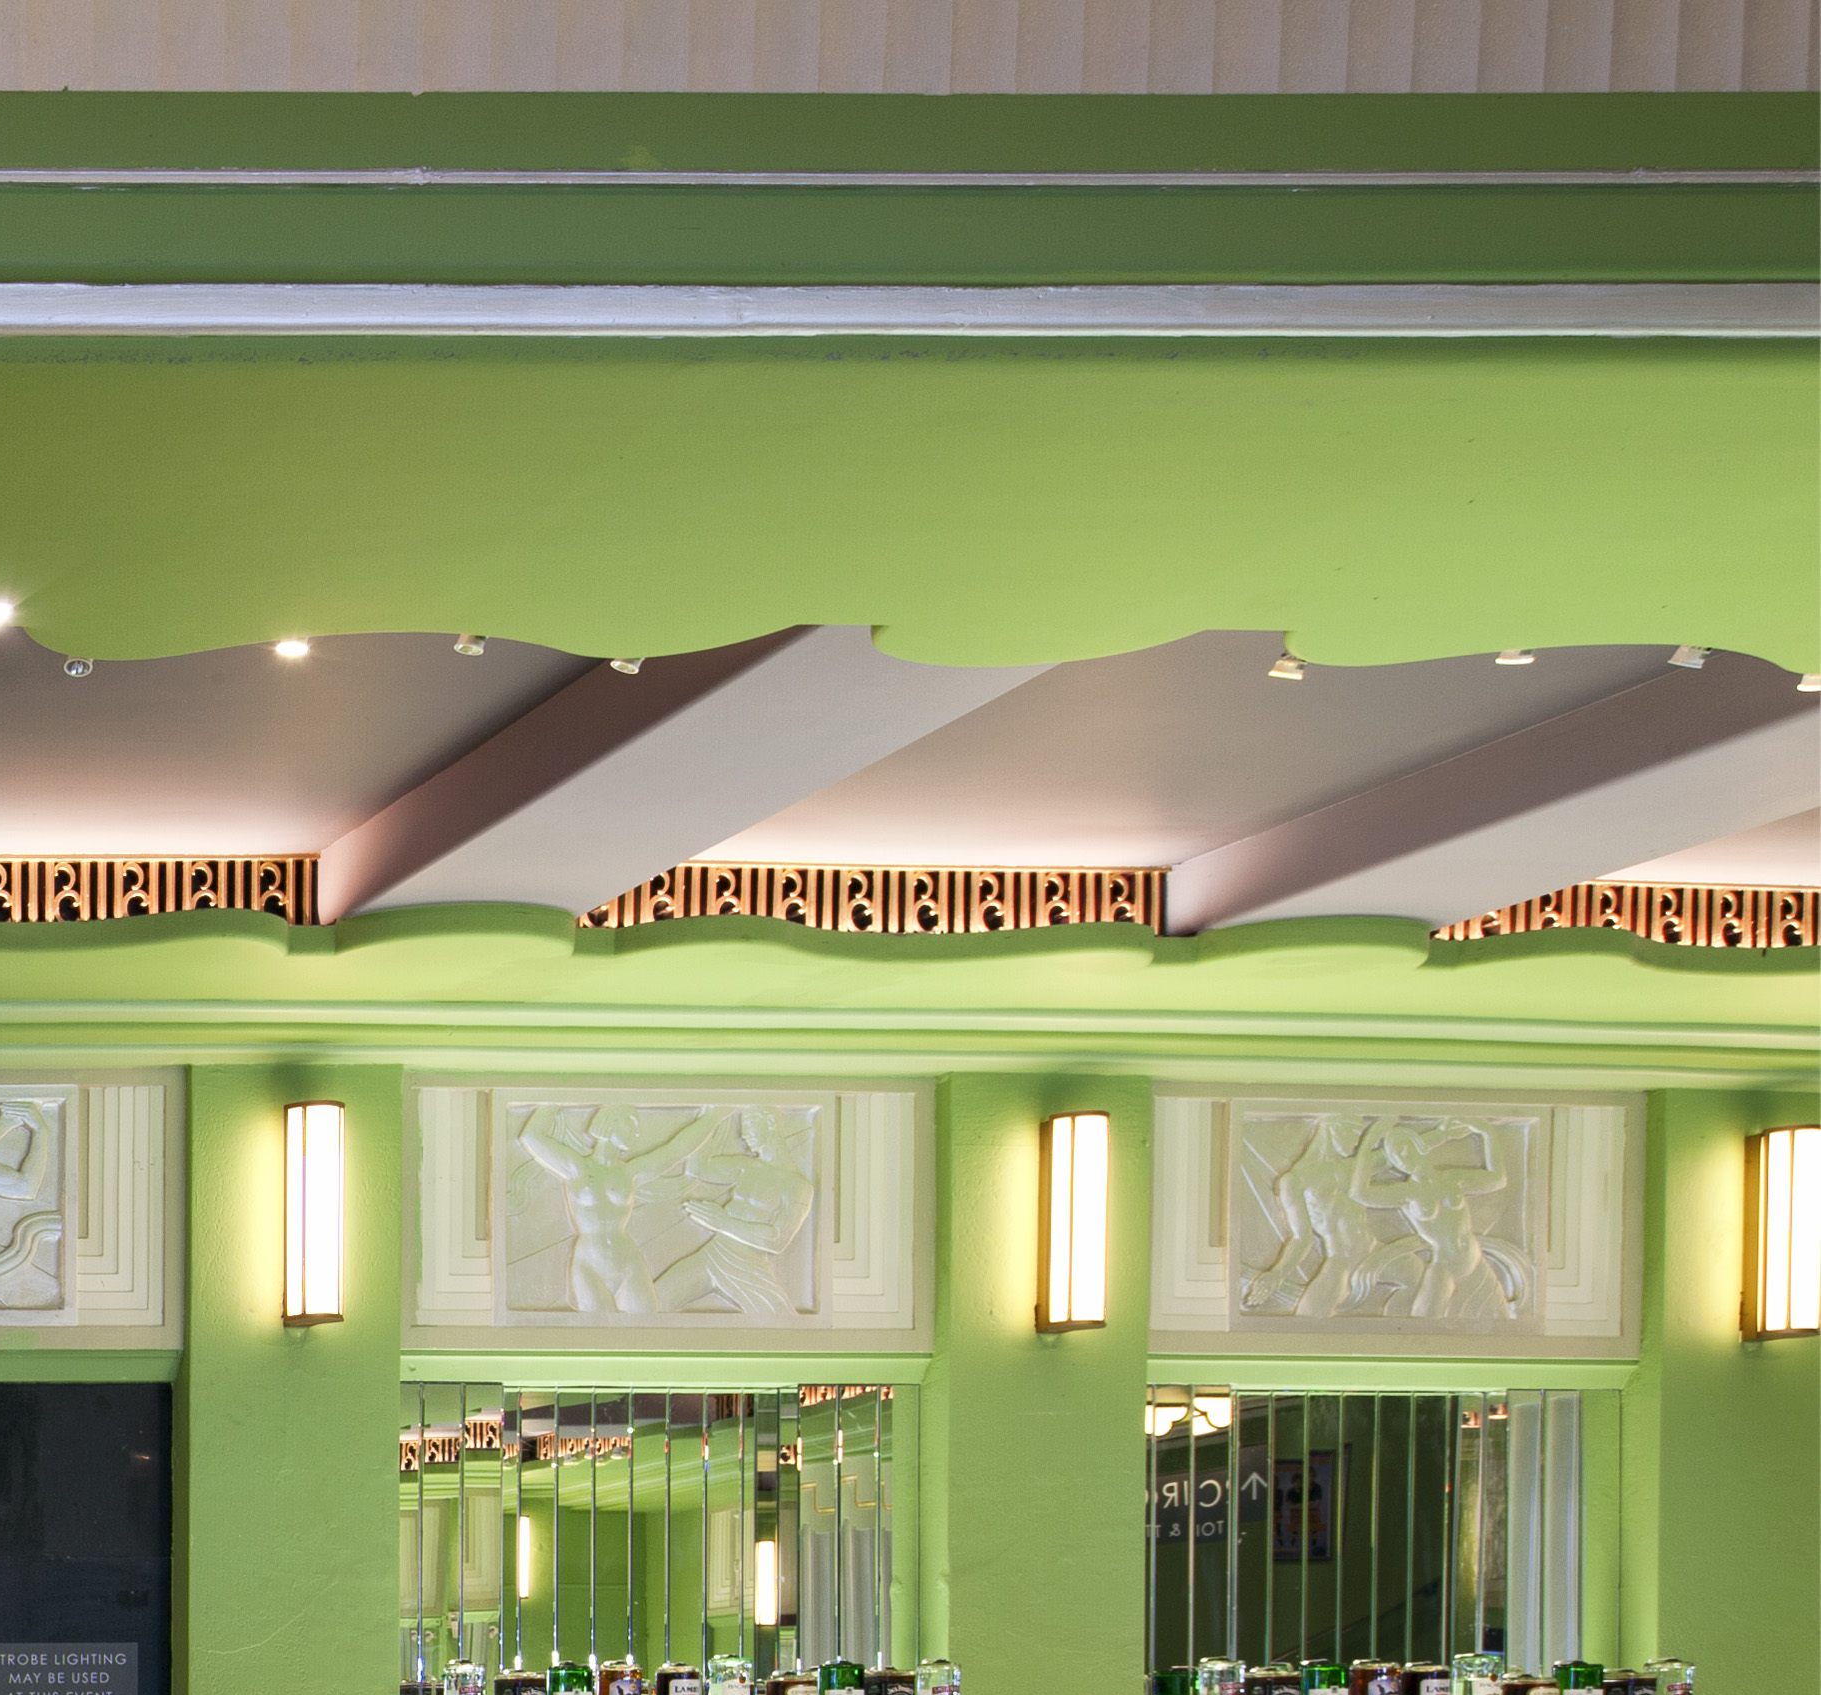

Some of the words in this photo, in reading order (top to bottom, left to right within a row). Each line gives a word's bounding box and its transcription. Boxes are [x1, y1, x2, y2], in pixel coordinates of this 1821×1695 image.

[54, 1653, 128, 1666] LIGHTING
[8, 1672, 42, 1684] MAY
[47, 1672, 65, 1684] BE
[71, 1672, 110, 1684] USED
